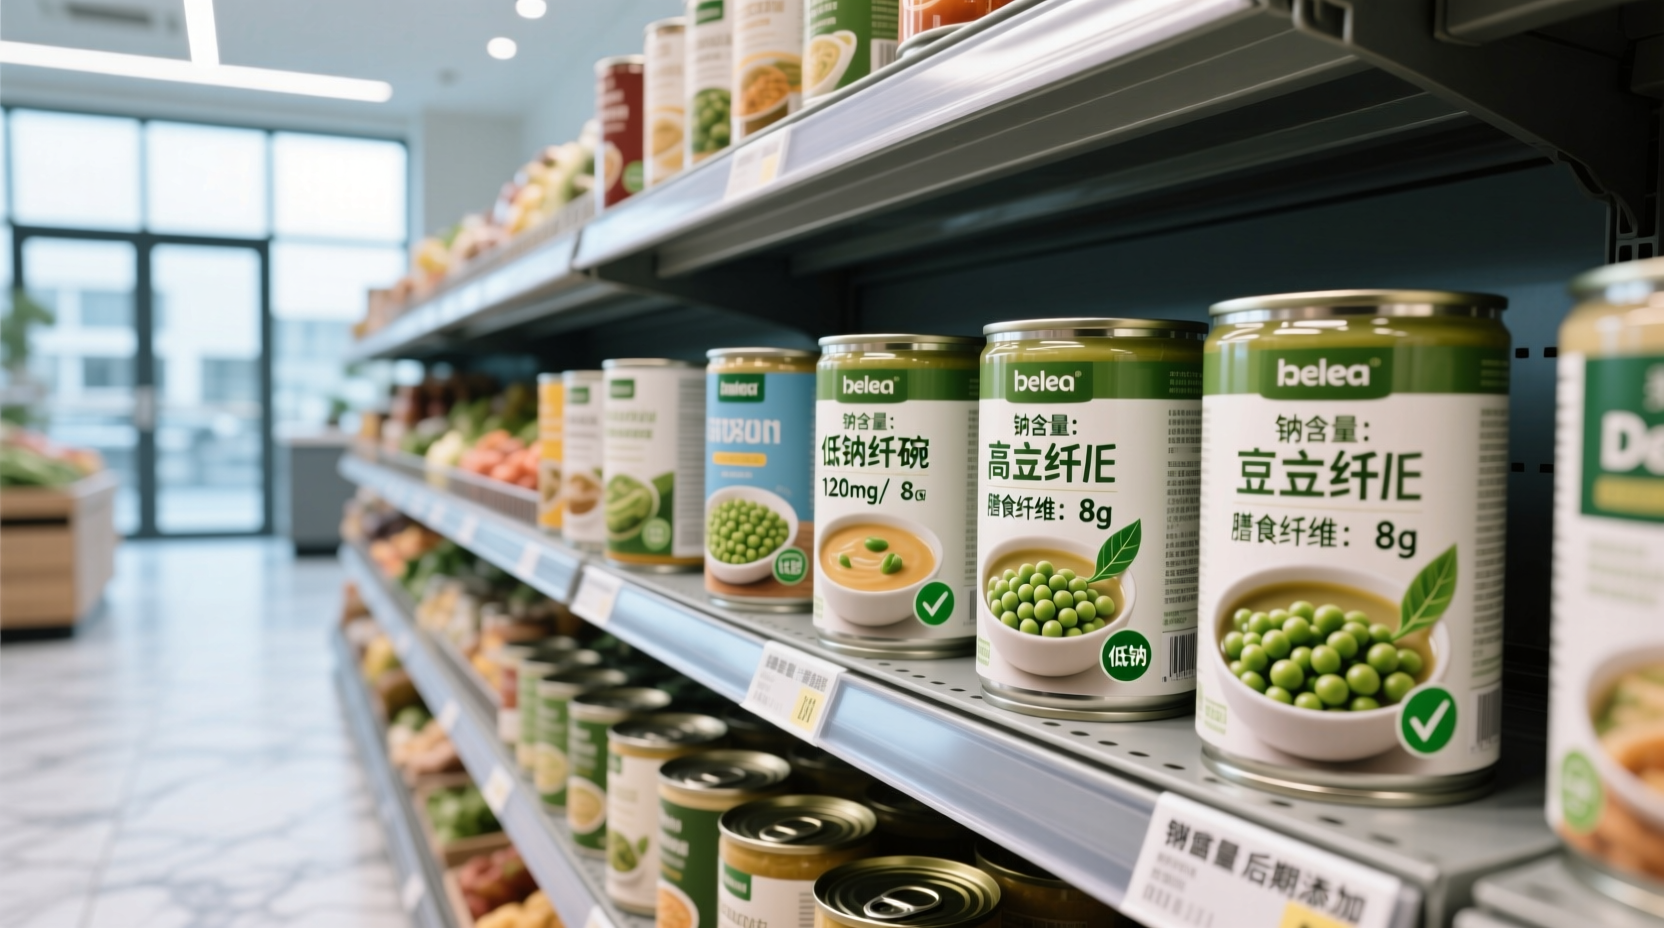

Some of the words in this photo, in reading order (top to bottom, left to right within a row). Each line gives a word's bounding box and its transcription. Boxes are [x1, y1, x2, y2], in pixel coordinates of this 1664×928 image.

[842, 374, 895, 395] belea
[1014, 369, 1076, 393] belea
[1277, 357, 1371, 387] belea
[1079, 498, 1113, 530] 8g
[1374, 520, 1418, 559] 8g
